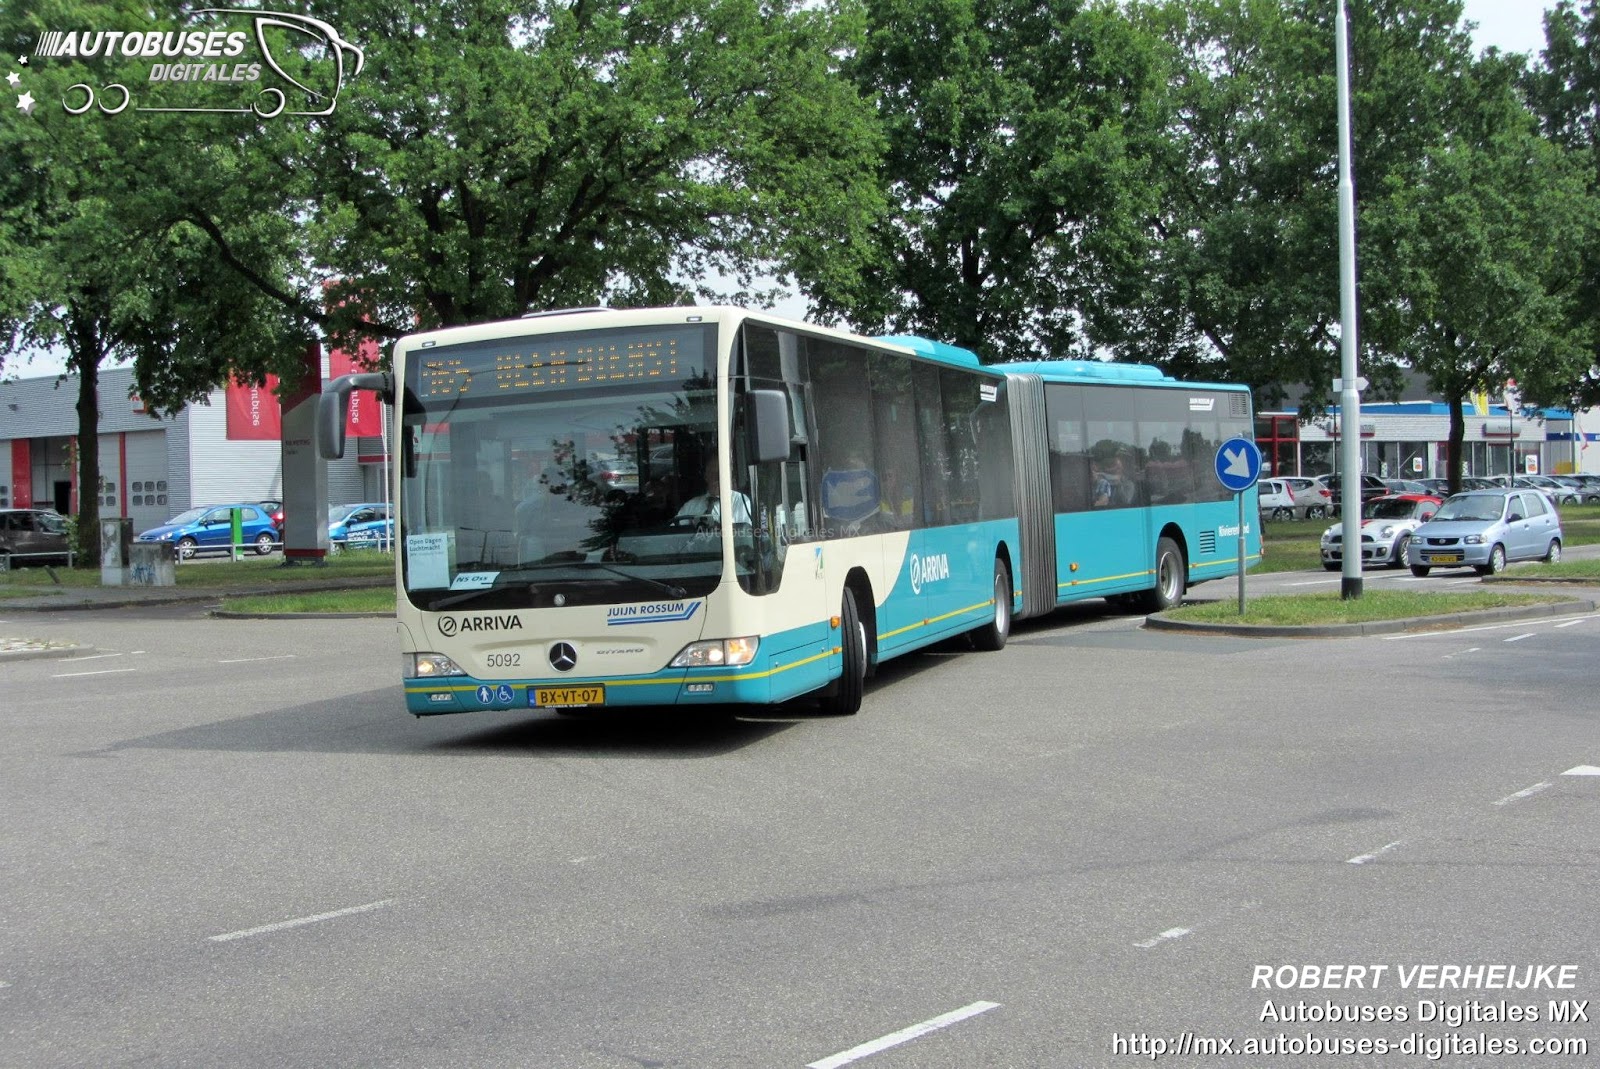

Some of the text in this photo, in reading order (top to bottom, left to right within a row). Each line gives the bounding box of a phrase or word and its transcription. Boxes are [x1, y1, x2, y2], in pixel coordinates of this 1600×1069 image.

[920, 553, 950, 584] ARRIVA
[607, 603, 684, 617] JUIJN ROSSUM
[460, 614, 523, 632] ARRIVA
[487, 653, 521, 668] 5092
[540, 689, 598, 704] BX-VT-07
